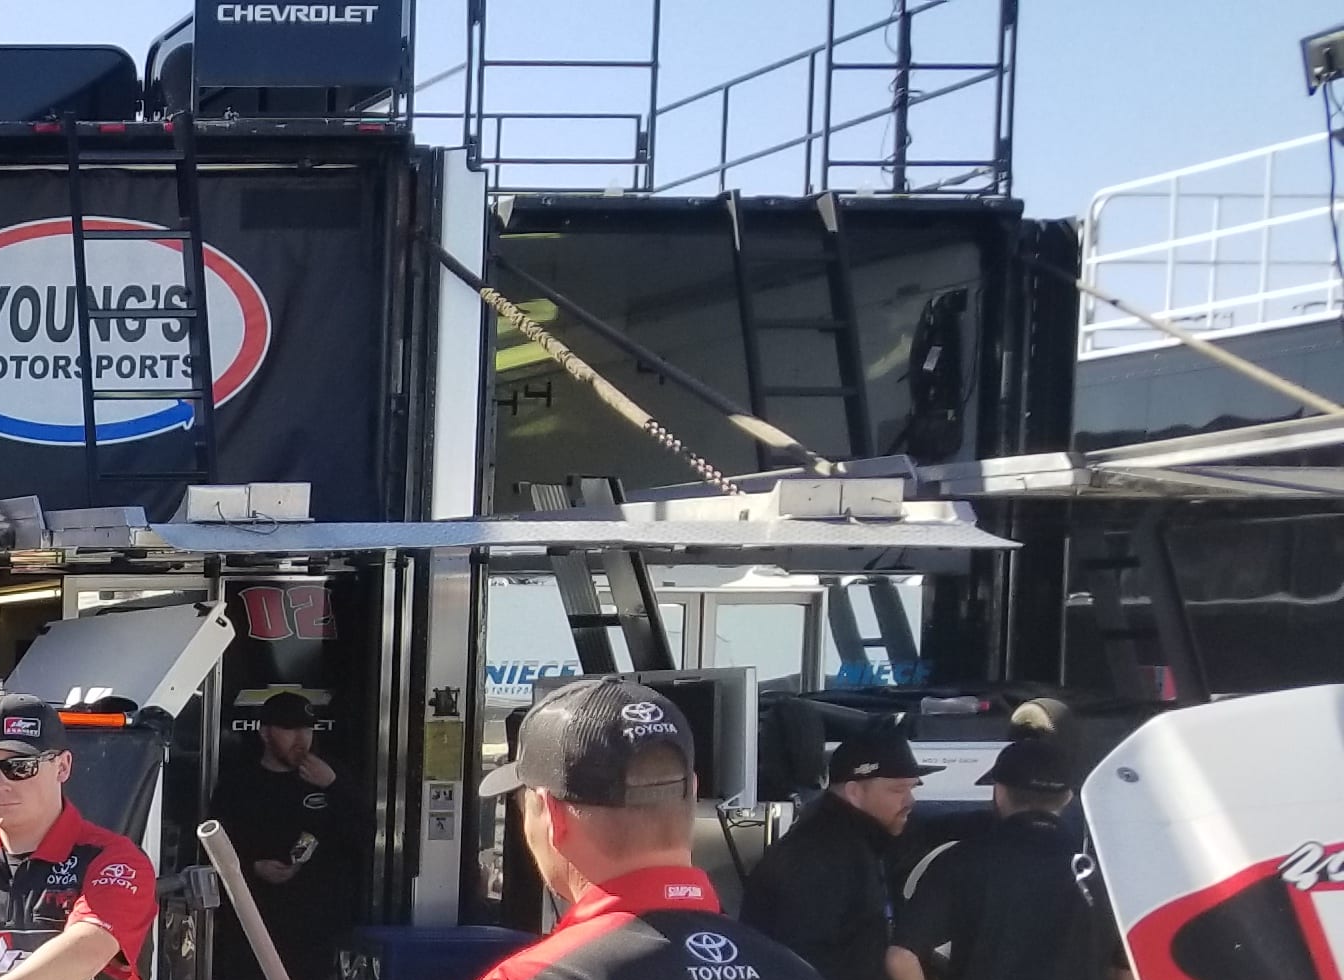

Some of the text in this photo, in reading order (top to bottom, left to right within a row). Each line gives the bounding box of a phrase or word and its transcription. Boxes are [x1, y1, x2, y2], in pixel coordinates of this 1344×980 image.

[216, 4, 380, 23] CHEVROLET
[238, 585, 339, 641] 02
[622, 722, 679, 745] TOYOTA
[91, 877, 138, 894] TOYOTA
